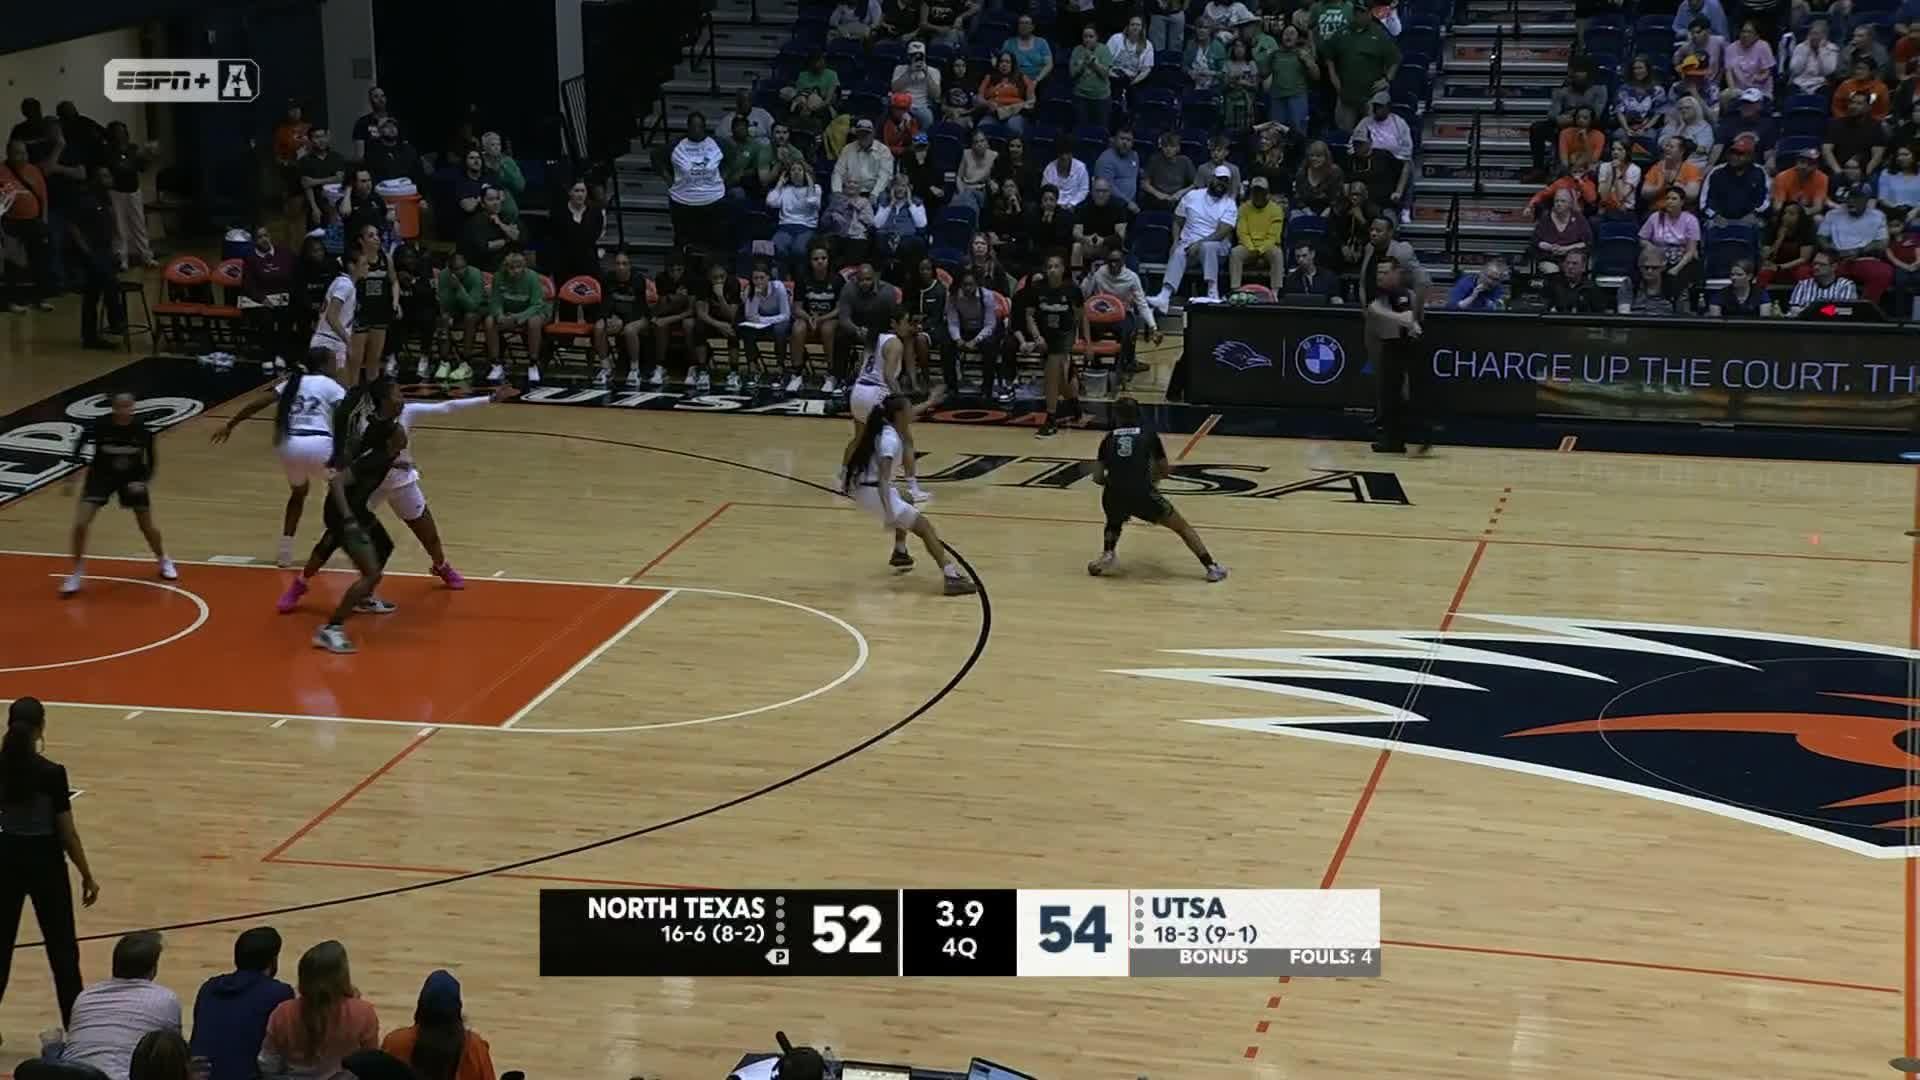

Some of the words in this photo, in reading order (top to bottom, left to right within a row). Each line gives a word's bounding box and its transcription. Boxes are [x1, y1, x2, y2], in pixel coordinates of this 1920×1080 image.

[1432, 348, 1572, 382] CHARGE
[1584, 355, 1630, 384] UP
[1639, 356, 1712, 387] THE
[1722, 359, 1850, 392] COURT.
[519, 386, 831, 416] UTSA
[898, 451, 1414, 505] UTSA
